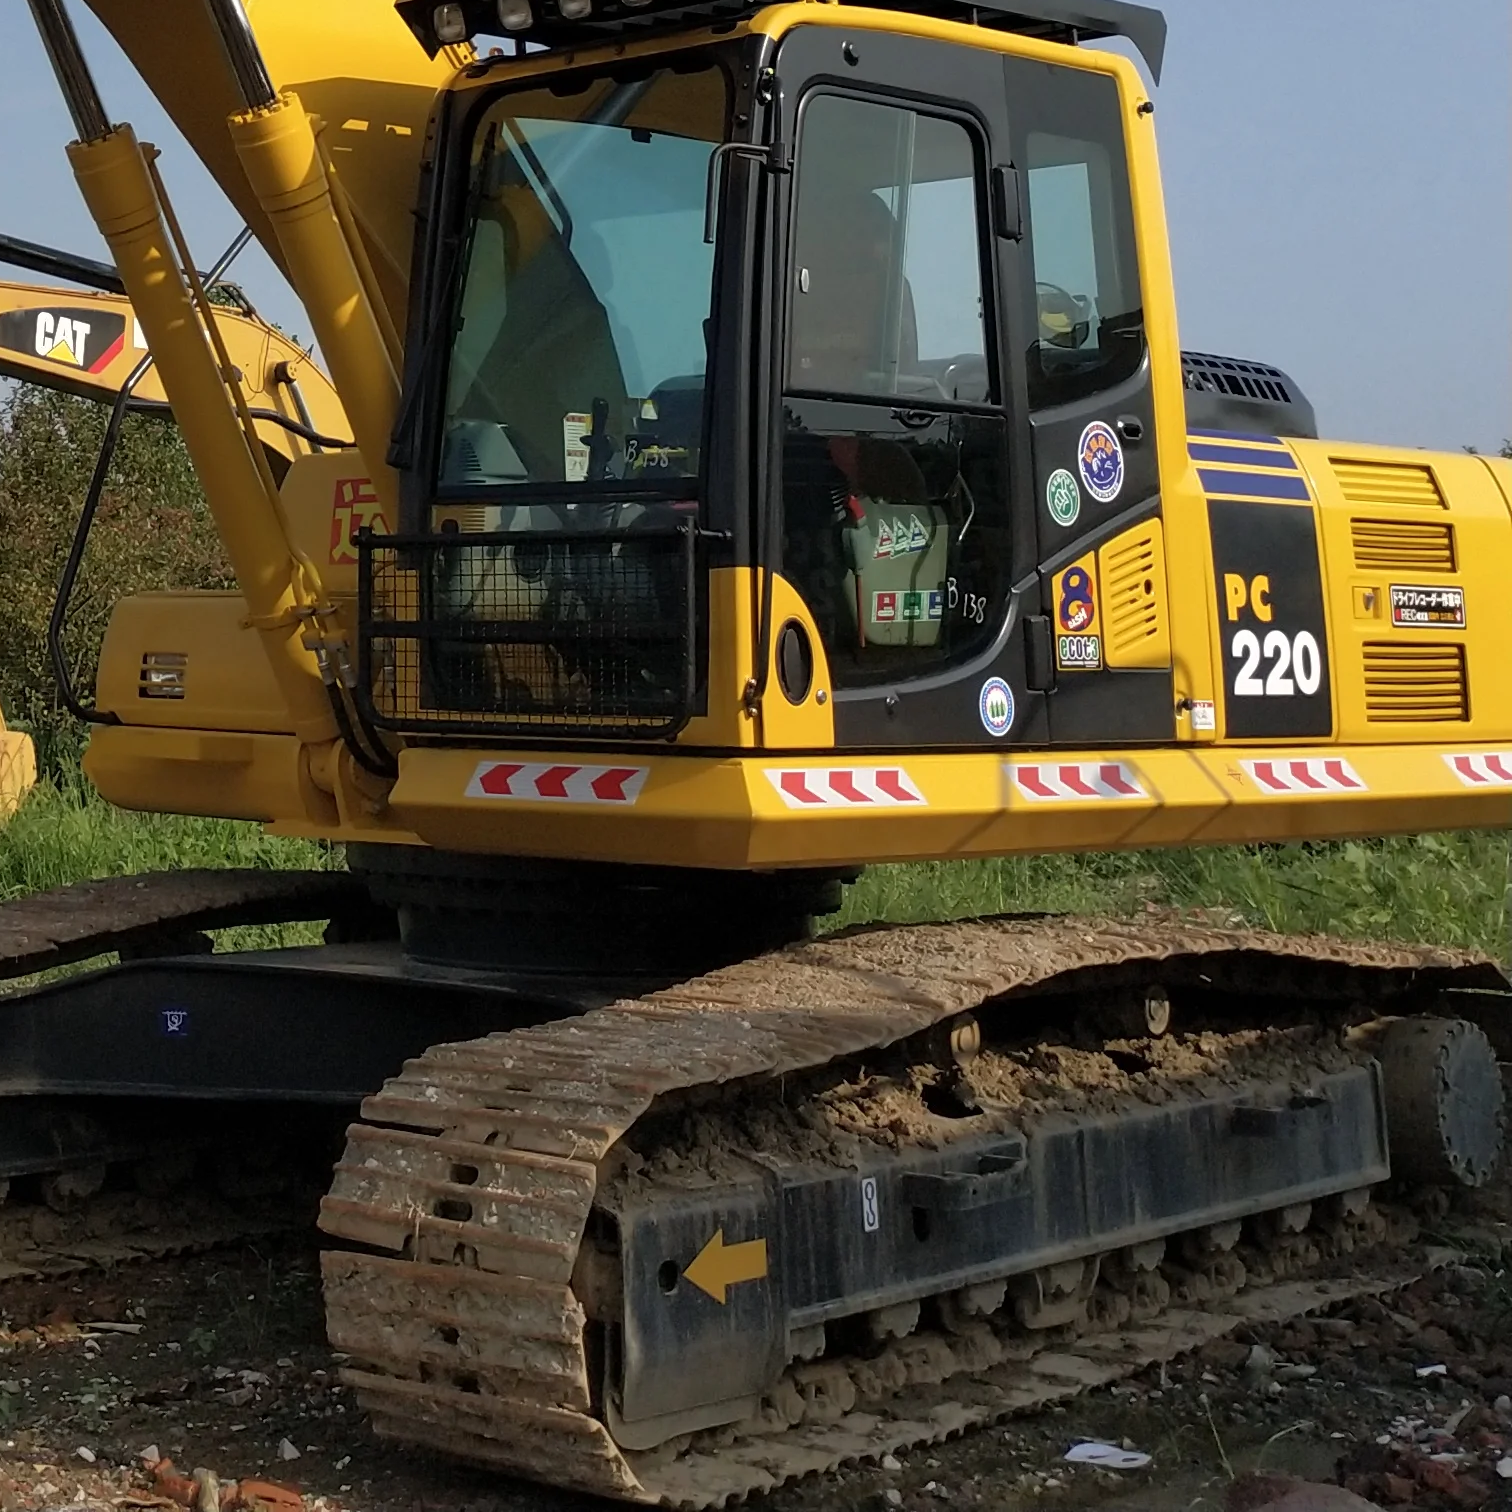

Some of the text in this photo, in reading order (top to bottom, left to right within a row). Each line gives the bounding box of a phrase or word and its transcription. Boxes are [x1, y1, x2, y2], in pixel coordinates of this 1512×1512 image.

[35, 311, 91, 367] CAT
[947, 577, 987, 624] B 138
[1224, 573, 1272, 622] PC
[1059, 636, 1099, 660] ecot3
[1231, 629, 1321, 696] 220
